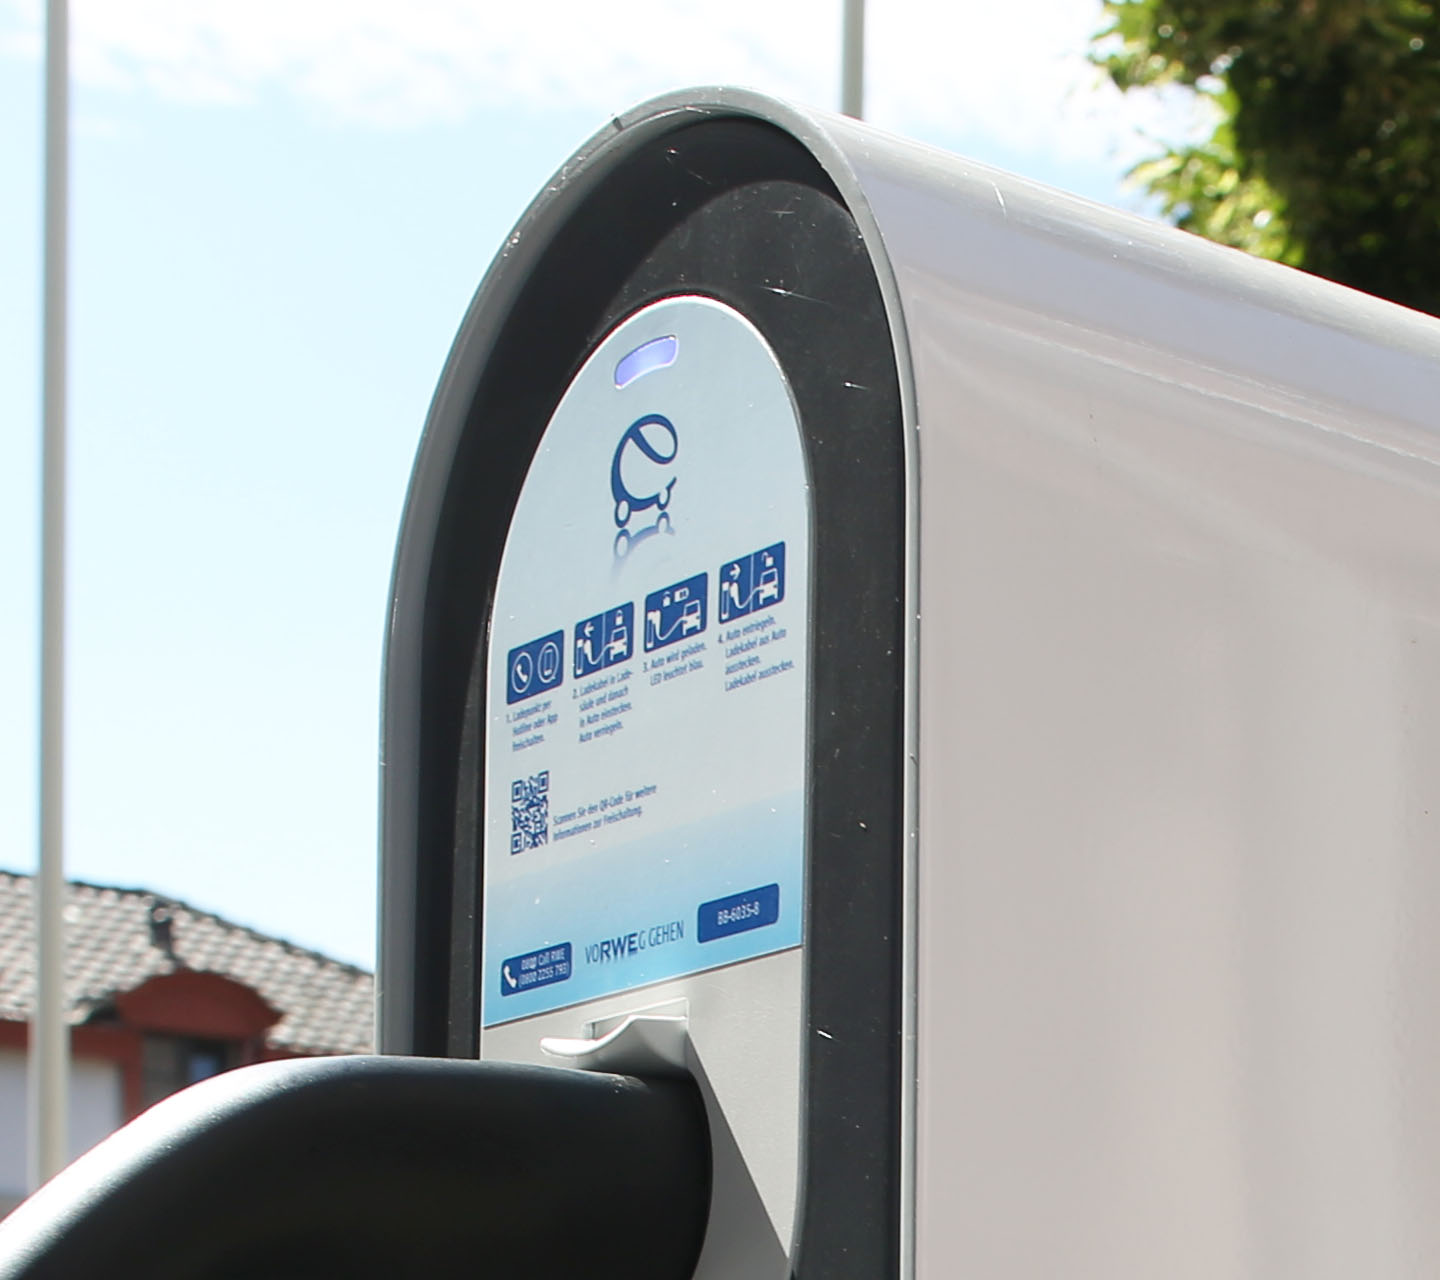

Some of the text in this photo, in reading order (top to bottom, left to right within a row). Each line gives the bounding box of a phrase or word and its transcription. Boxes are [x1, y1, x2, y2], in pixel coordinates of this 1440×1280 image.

[726, 628, 741, 641] Auto
[651, 656, 665, 670] Auto
[666, 650, 680, 665] wird
[650, 672, 662, 687] LED
[585, 919, 685, 964] VORWEG GEHEN
